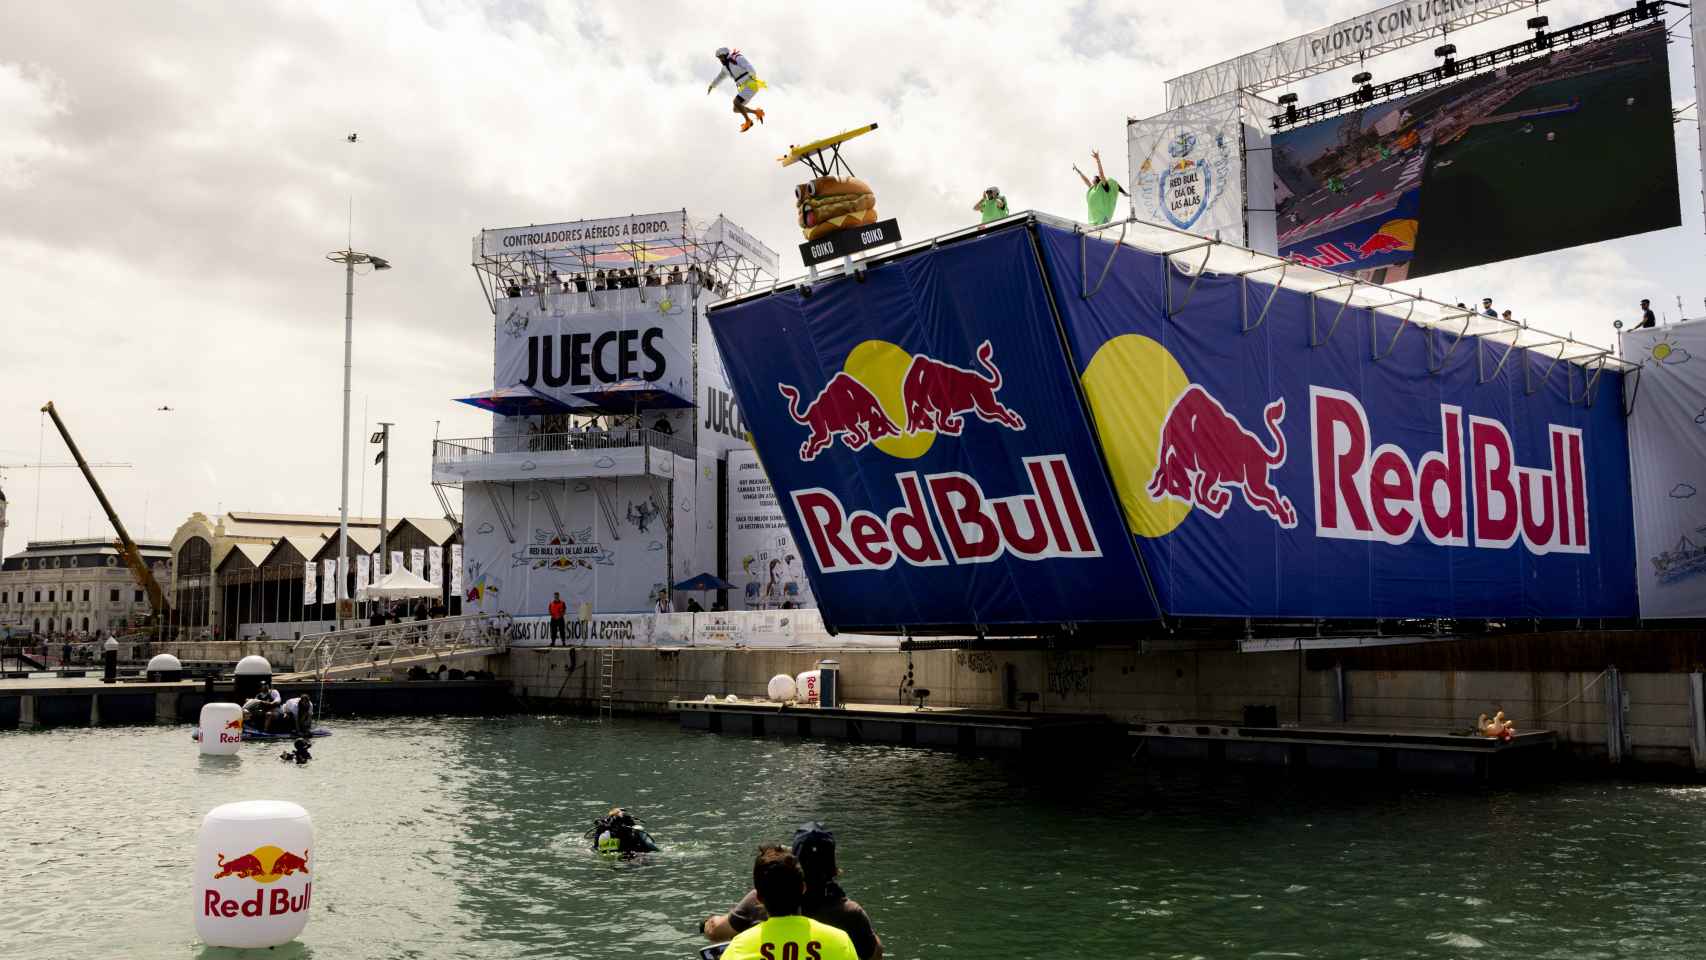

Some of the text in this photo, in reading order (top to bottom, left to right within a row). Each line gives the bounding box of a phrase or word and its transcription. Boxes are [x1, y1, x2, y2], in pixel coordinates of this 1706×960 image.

[1311, 17, 1373, 57] PILOTOS
[1377, 10, 1412, 35] CON
[1169, 172, 1199, 188] RED BULL
[1186, 185, 1196, 195] DE
[1171, 196, 1201, 211] LAS ALAS
[503, 220, 670, 248] CONTROLADORES AÉREOS A BORDO.
[861, 228, 884, 245] GOIKO
[810, 241, 834, 258] GOIKO
[520, 327, 666, 388] JUECES
[1309, 384, 1590, 556] Red Bull
[790, 453, 1104, 574] Red Bull
[583, 546, 598, 554] ALAS
[220, 732, 241, 744] Red
[204, 881, 312, 918] Red Bull
